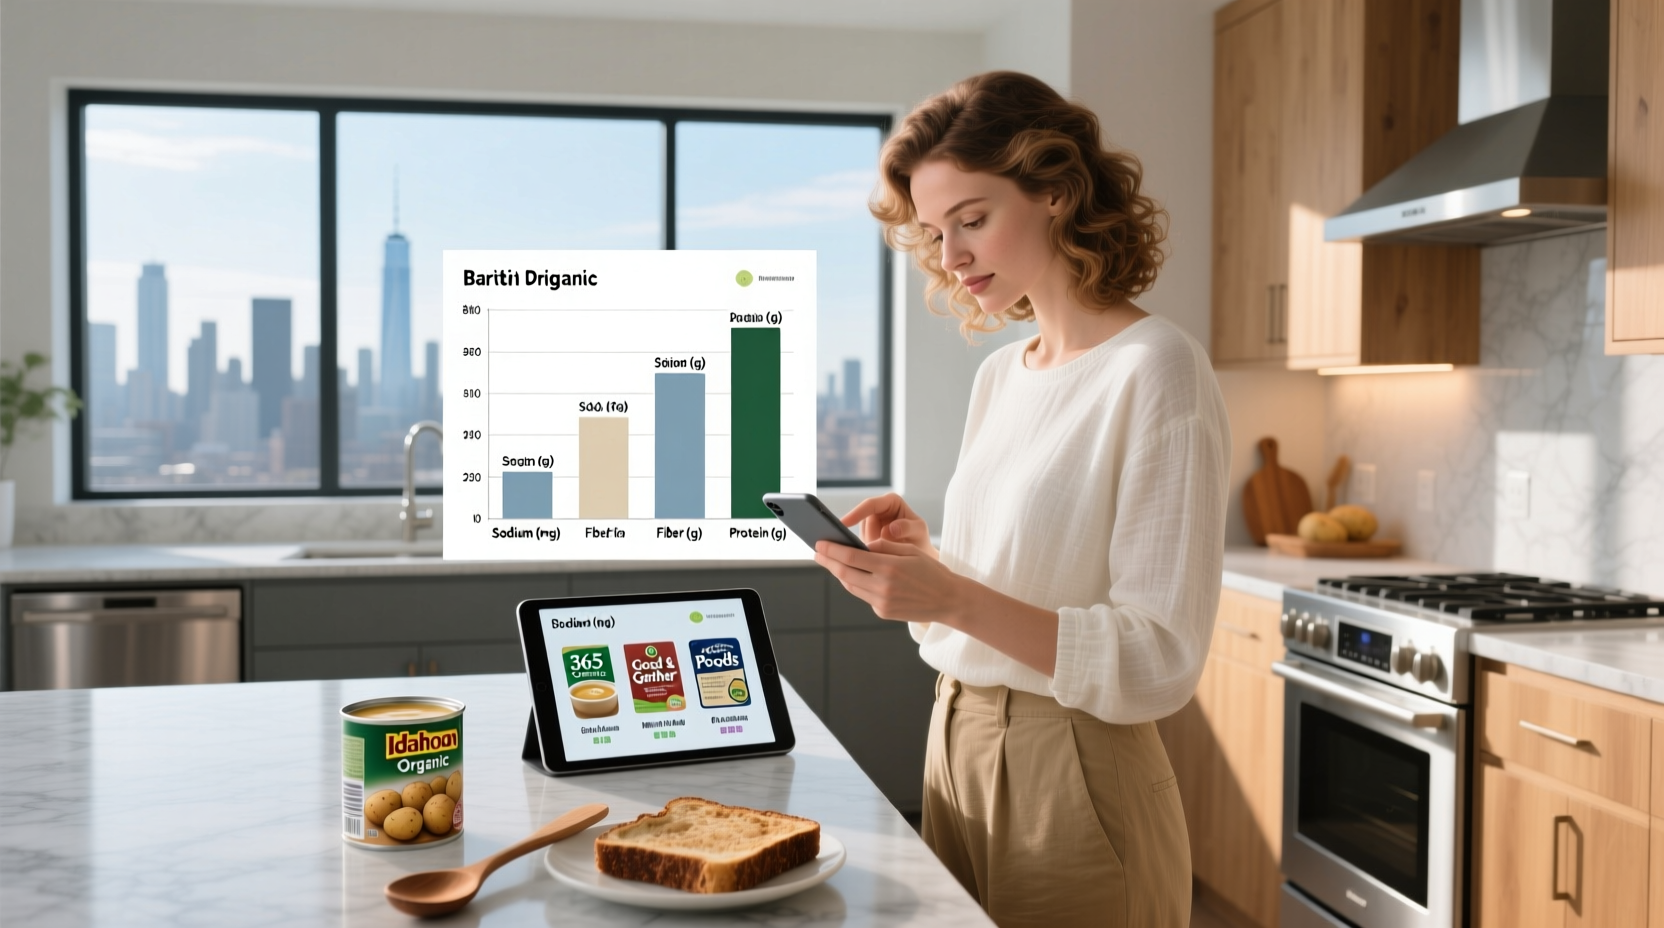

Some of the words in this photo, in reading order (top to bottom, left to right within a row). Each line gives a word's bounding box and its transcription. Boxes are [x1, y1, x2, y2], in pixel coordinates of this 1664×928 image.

[690, 357, 705, 370] (g)
[538, 455, 554, 468] (g)
[657, 527, 684, 538] Fiber
[687, 527, 702, 541] (g)
[730, 527, 768, 538] Protein
[771, 527, 786, 541] (g)
[570, 653, 603, 671] 365
[397, 755, 449, 774] Organic
